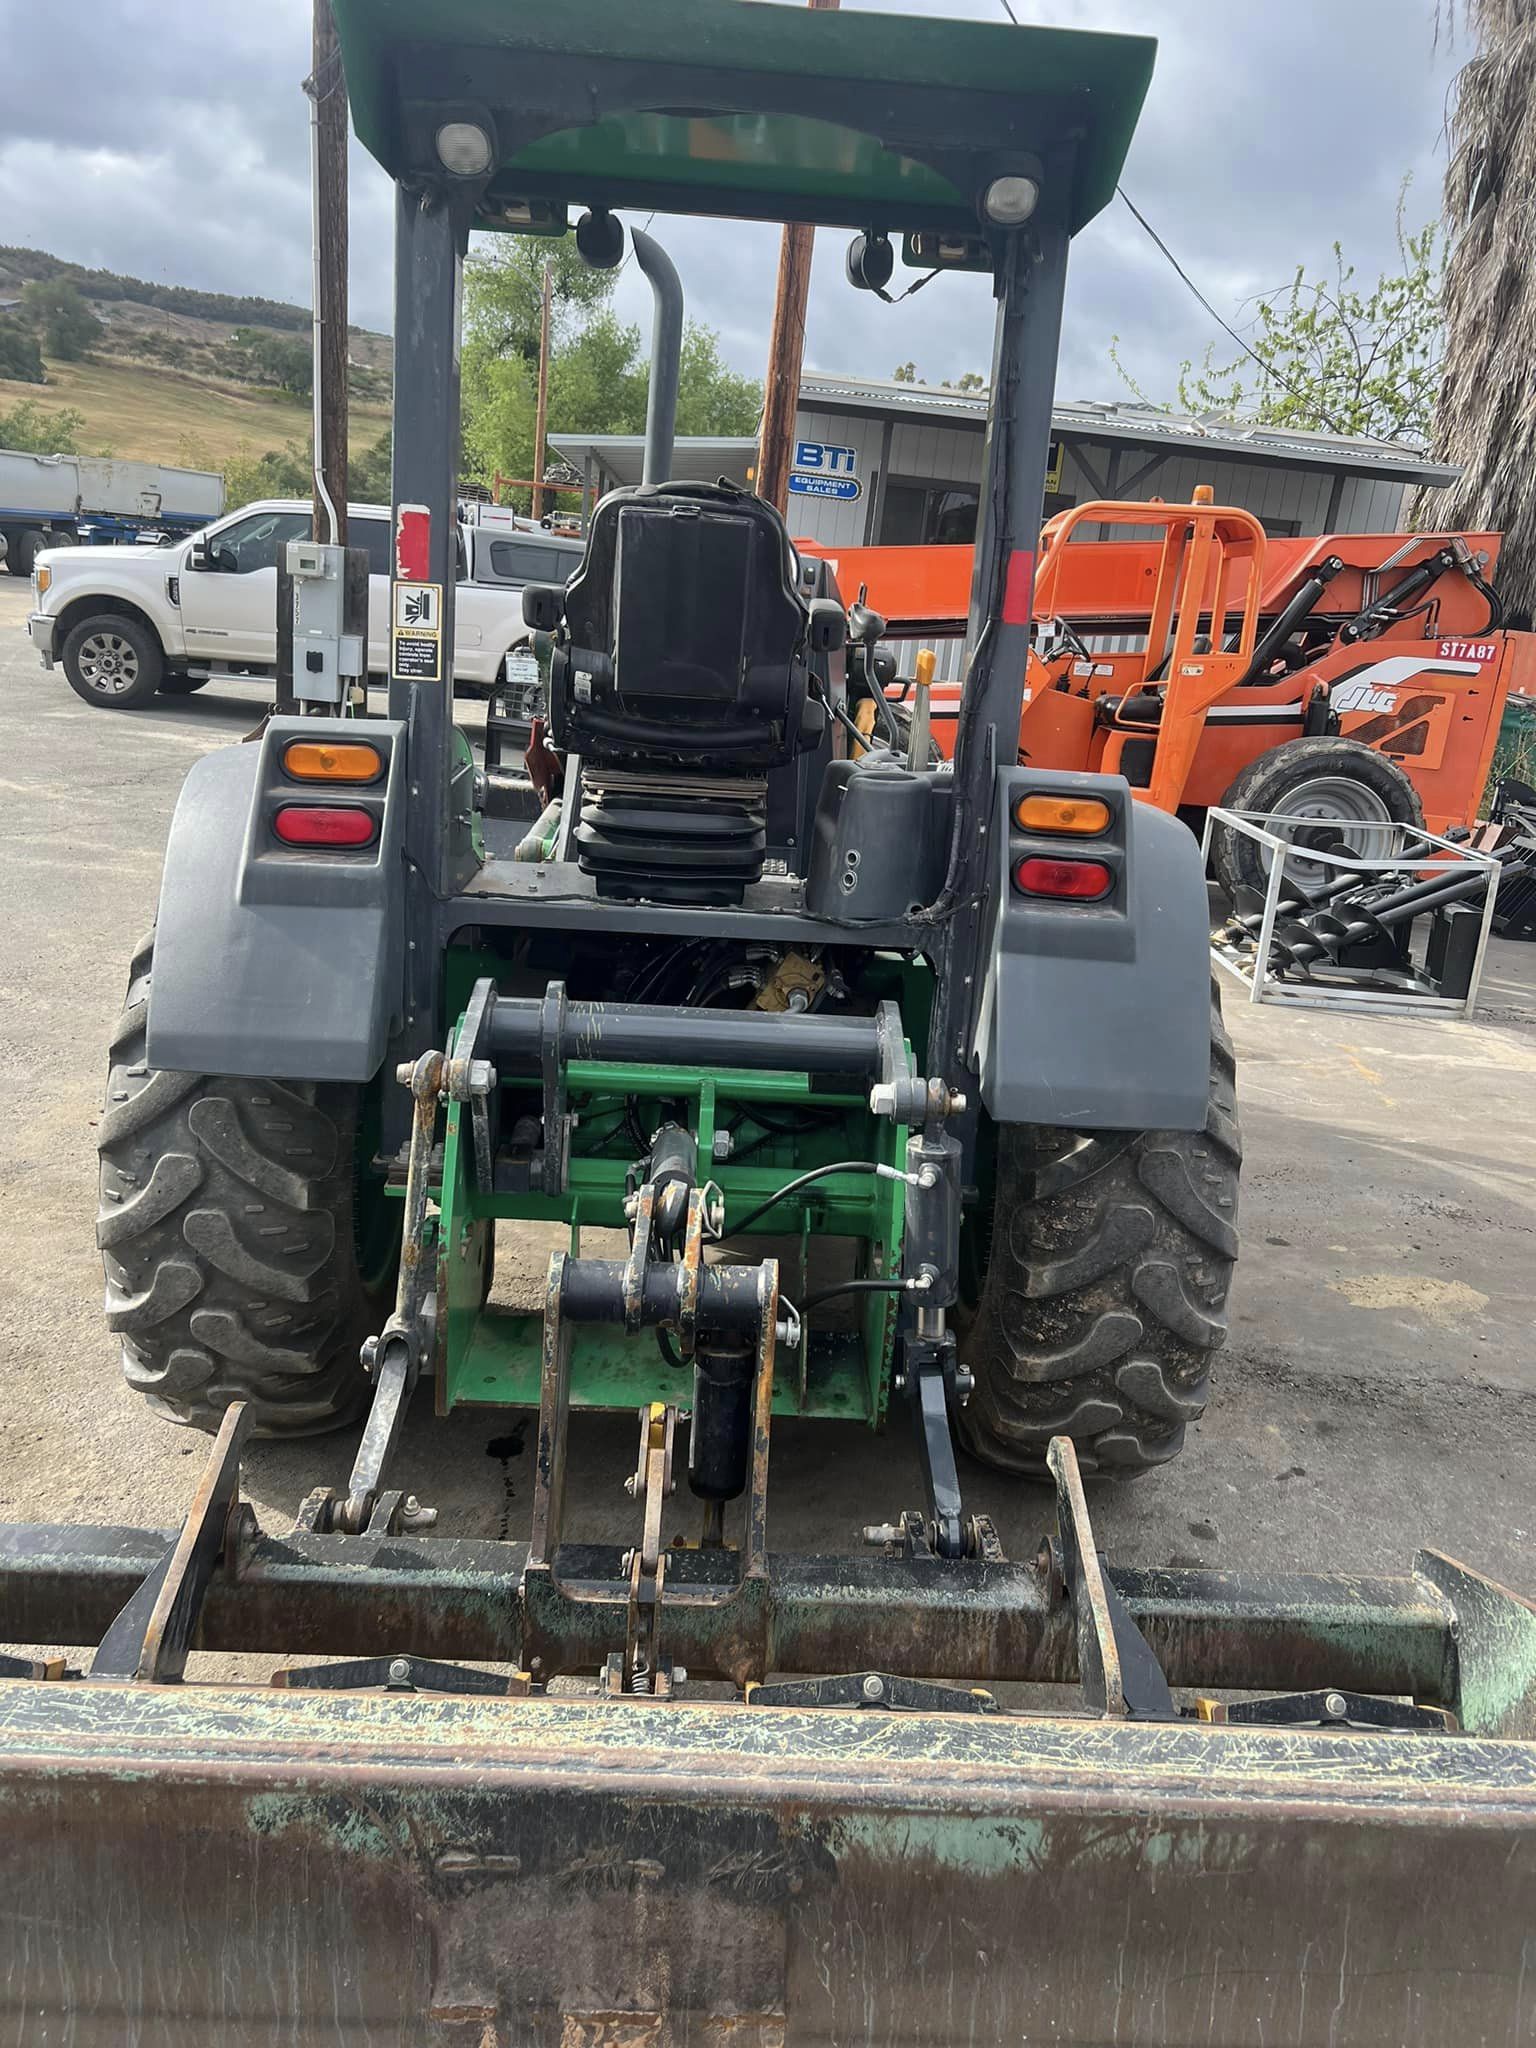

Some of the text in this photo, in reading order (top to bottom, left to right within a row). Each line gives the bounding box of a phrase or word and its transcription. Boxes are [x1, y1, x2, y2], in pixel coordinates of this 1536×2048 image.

[794, 476, 851, 489] EQUIPMENT
[806, 485, 838, 495] SALES
[404, 630, 437, 638] WARNING
[1440, 642, 1496, 660] ST7A87
